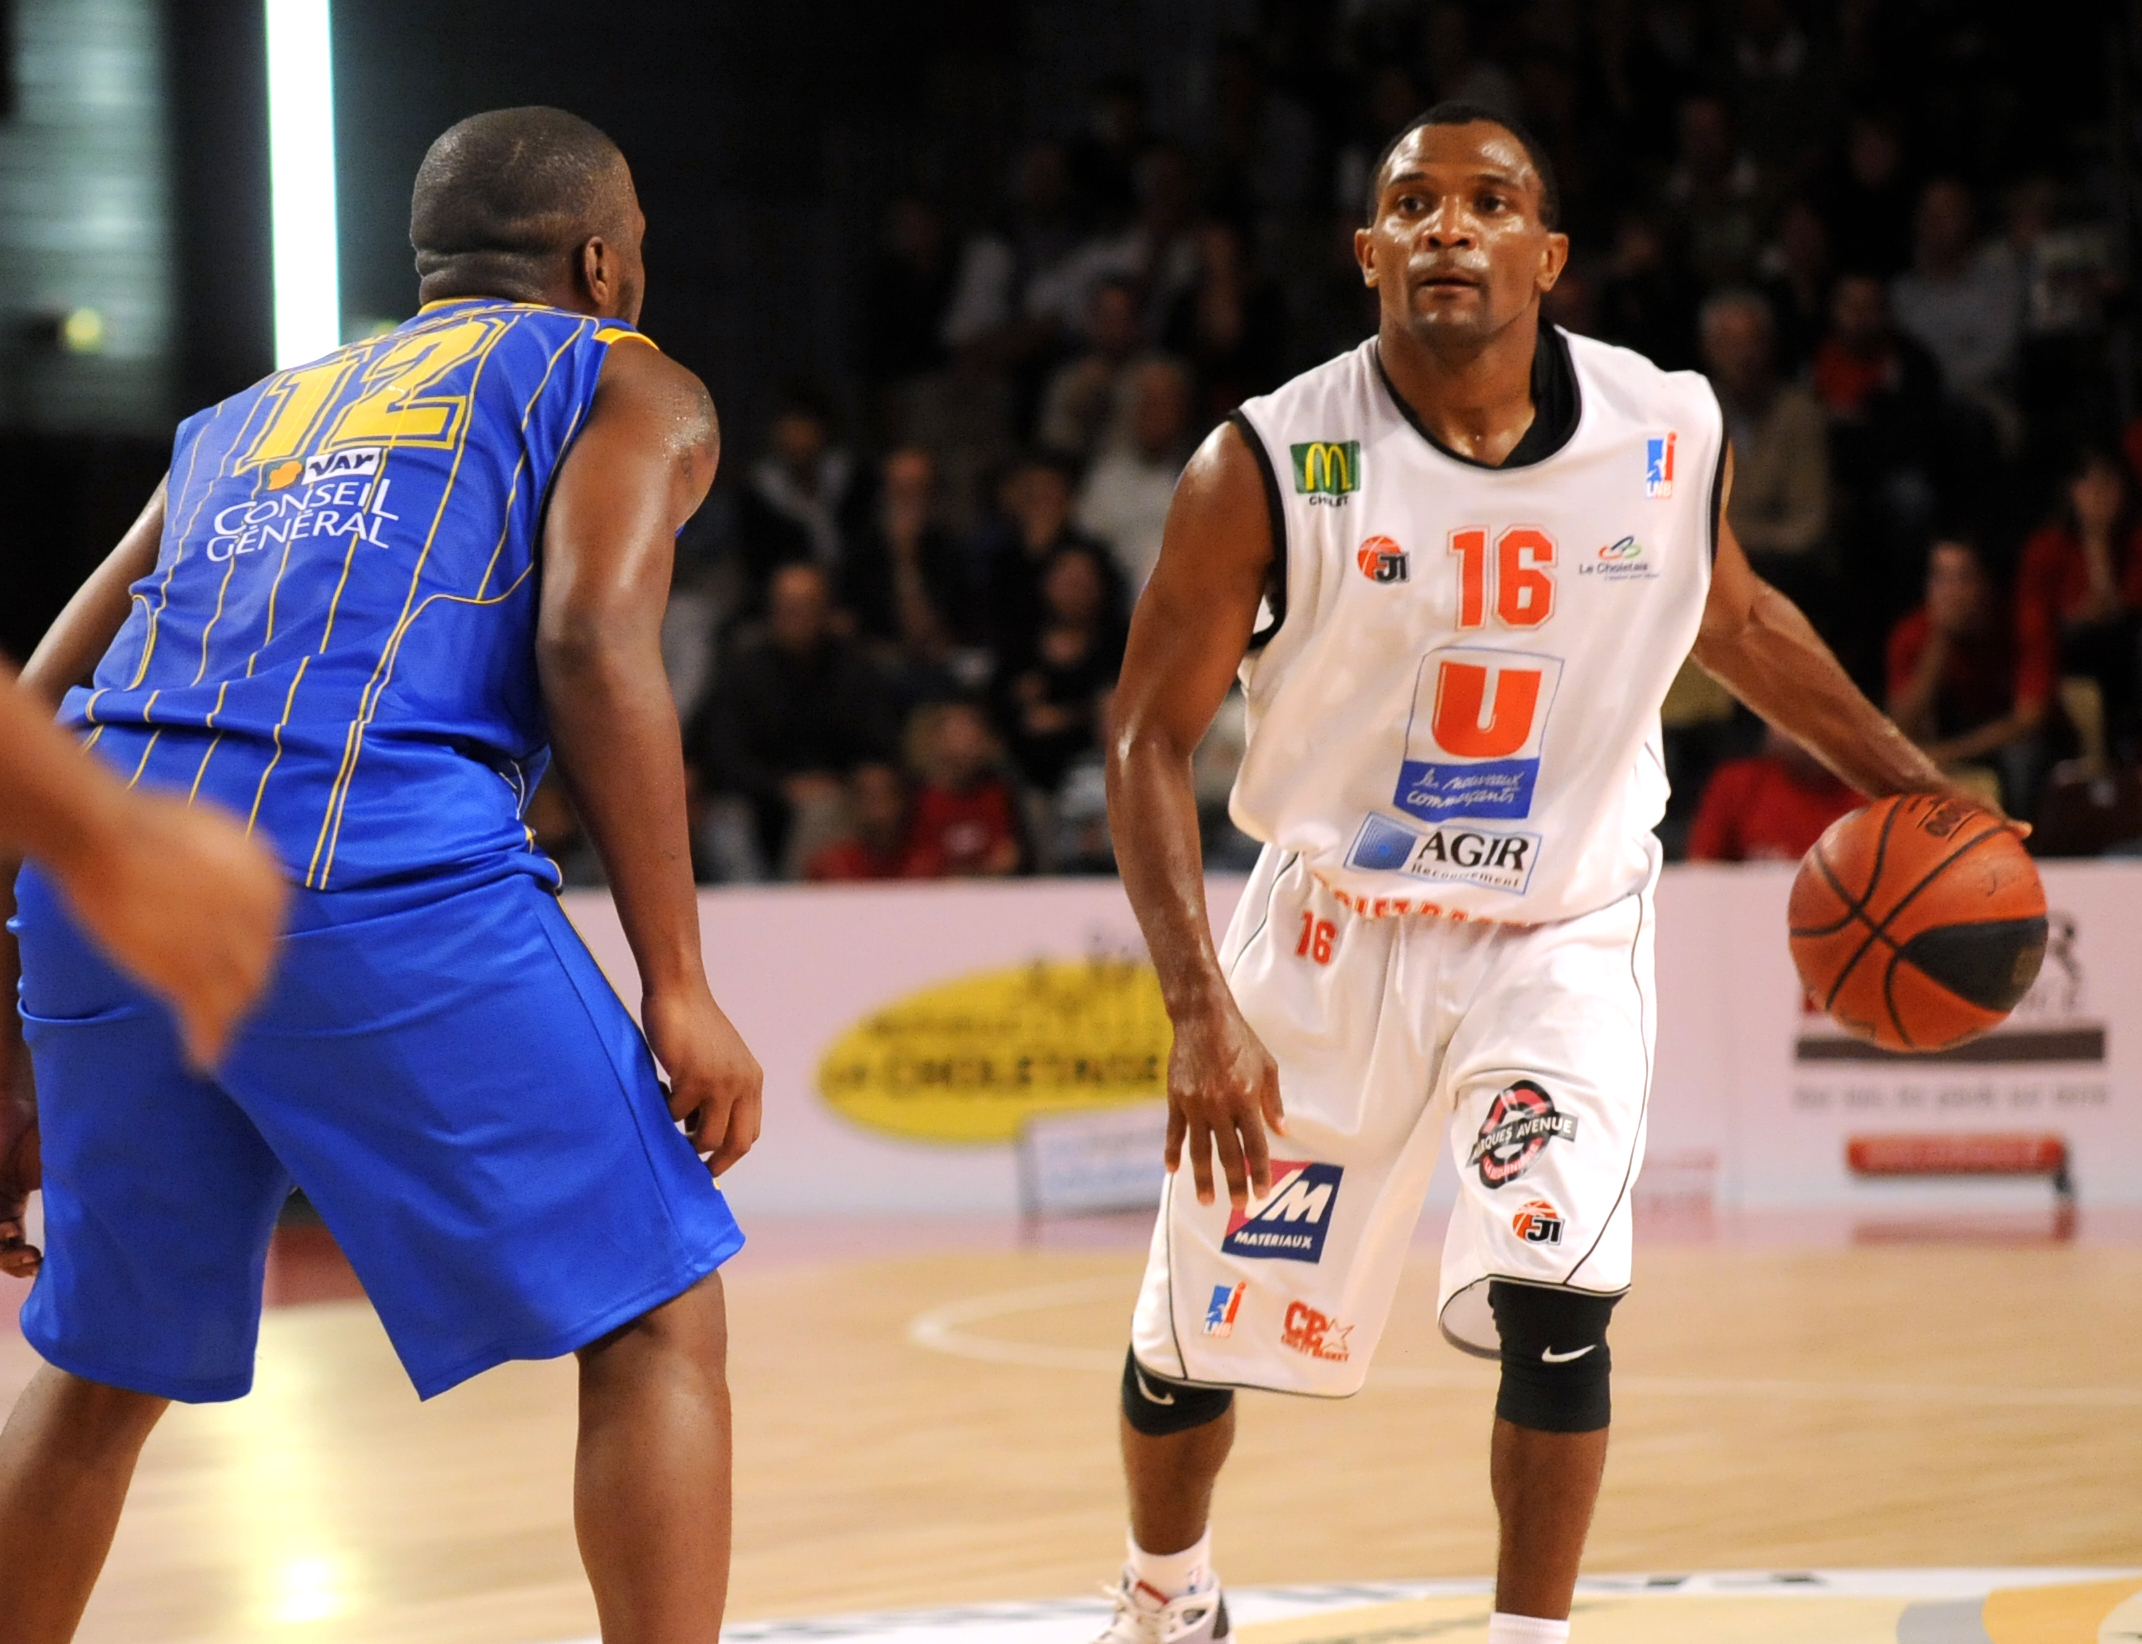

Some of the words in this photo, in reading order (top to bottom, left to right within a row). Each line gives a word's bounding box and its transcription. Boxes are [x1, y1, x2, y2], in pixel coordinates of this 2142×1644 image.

[233, 316, 505, 478] 12
[214, 479, 399, 536] CONSEIL
[1447, 525, 1558, 631] 16
[1432, 661, 1542, 758] U
[1417, 830, 1529, 871] AGIR
[1295, 910, 1338, 966] 16
[1517, 1117, 1573, 1139] AVENUE
